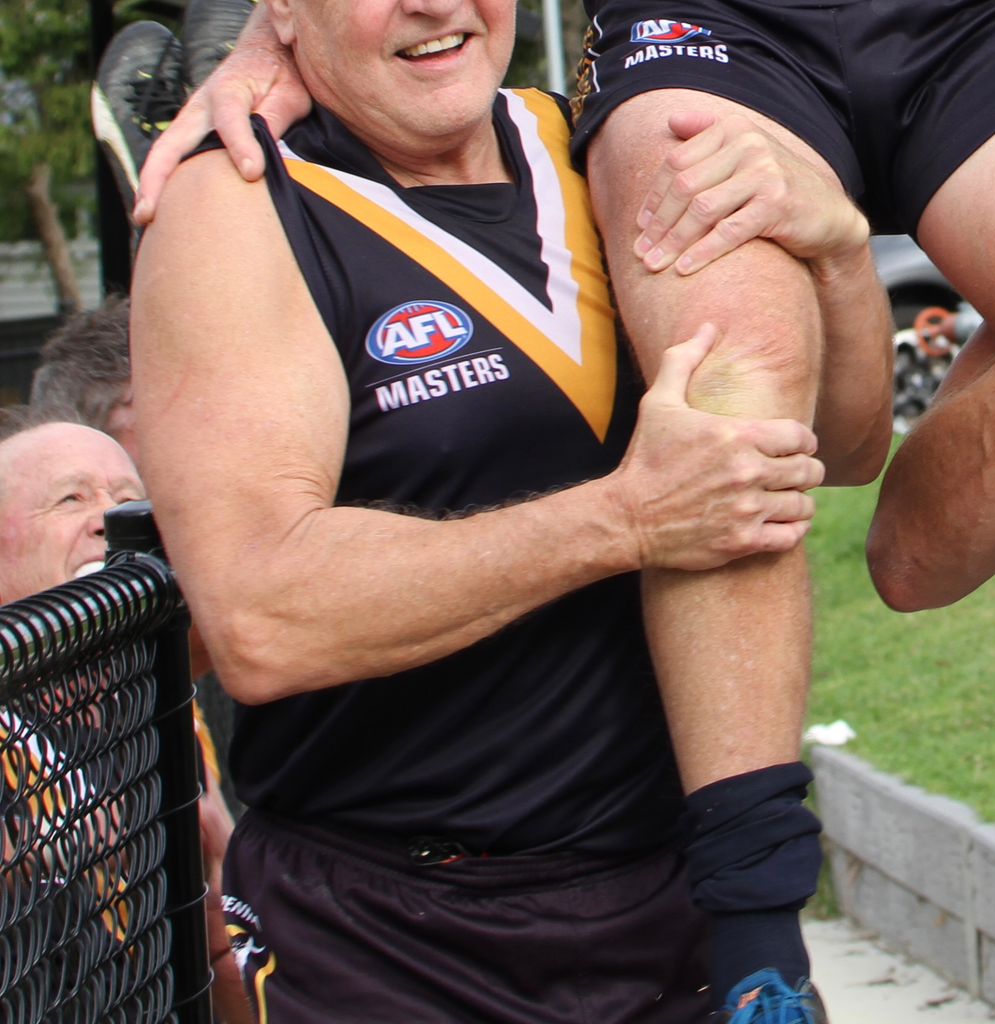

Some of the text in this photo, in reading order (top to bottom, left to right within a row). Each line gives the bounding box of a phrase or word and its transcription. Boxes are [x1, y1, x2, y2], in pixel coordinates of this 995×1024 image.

[624, 44, 729, 69] MASTERS
[381, 310, 468, 357] AFL
[375, 354, 511, 412] MASTERS
